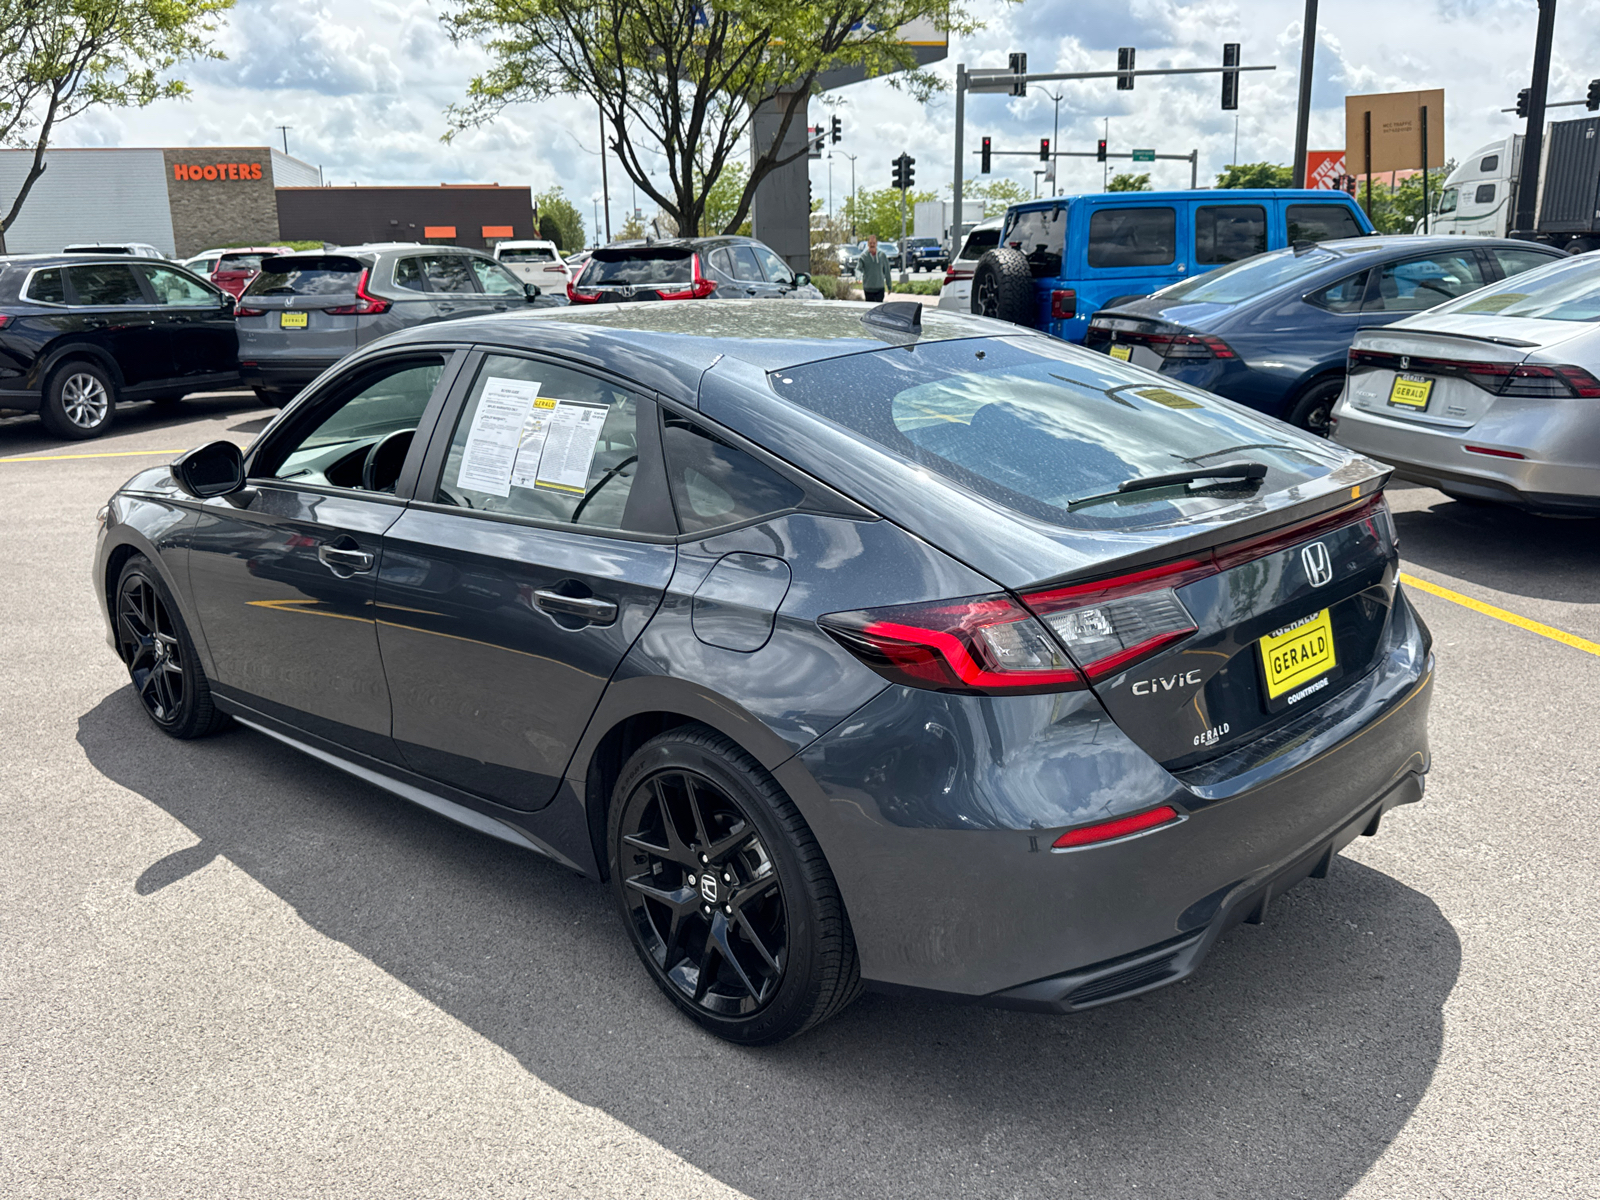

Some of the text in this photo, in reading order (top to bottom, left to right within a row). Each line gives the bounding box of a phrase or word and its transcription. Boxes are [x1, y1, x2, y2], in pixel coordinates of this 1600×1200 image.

[173, 163, 263, 181] HOOTERS
[1311, 157, 1335, 181] THE
[1402, 374, 1426, 383] GERALD
[1396, 387, 1424, 399] GERALD
[1273, 636, 1325, 675] GERALD
[1132, 668, 1202, 696] CIVIC
[1287, 677, 1330, 705] COUNTRYSIDE
[1193, 722, 1230, 746] GERALD
